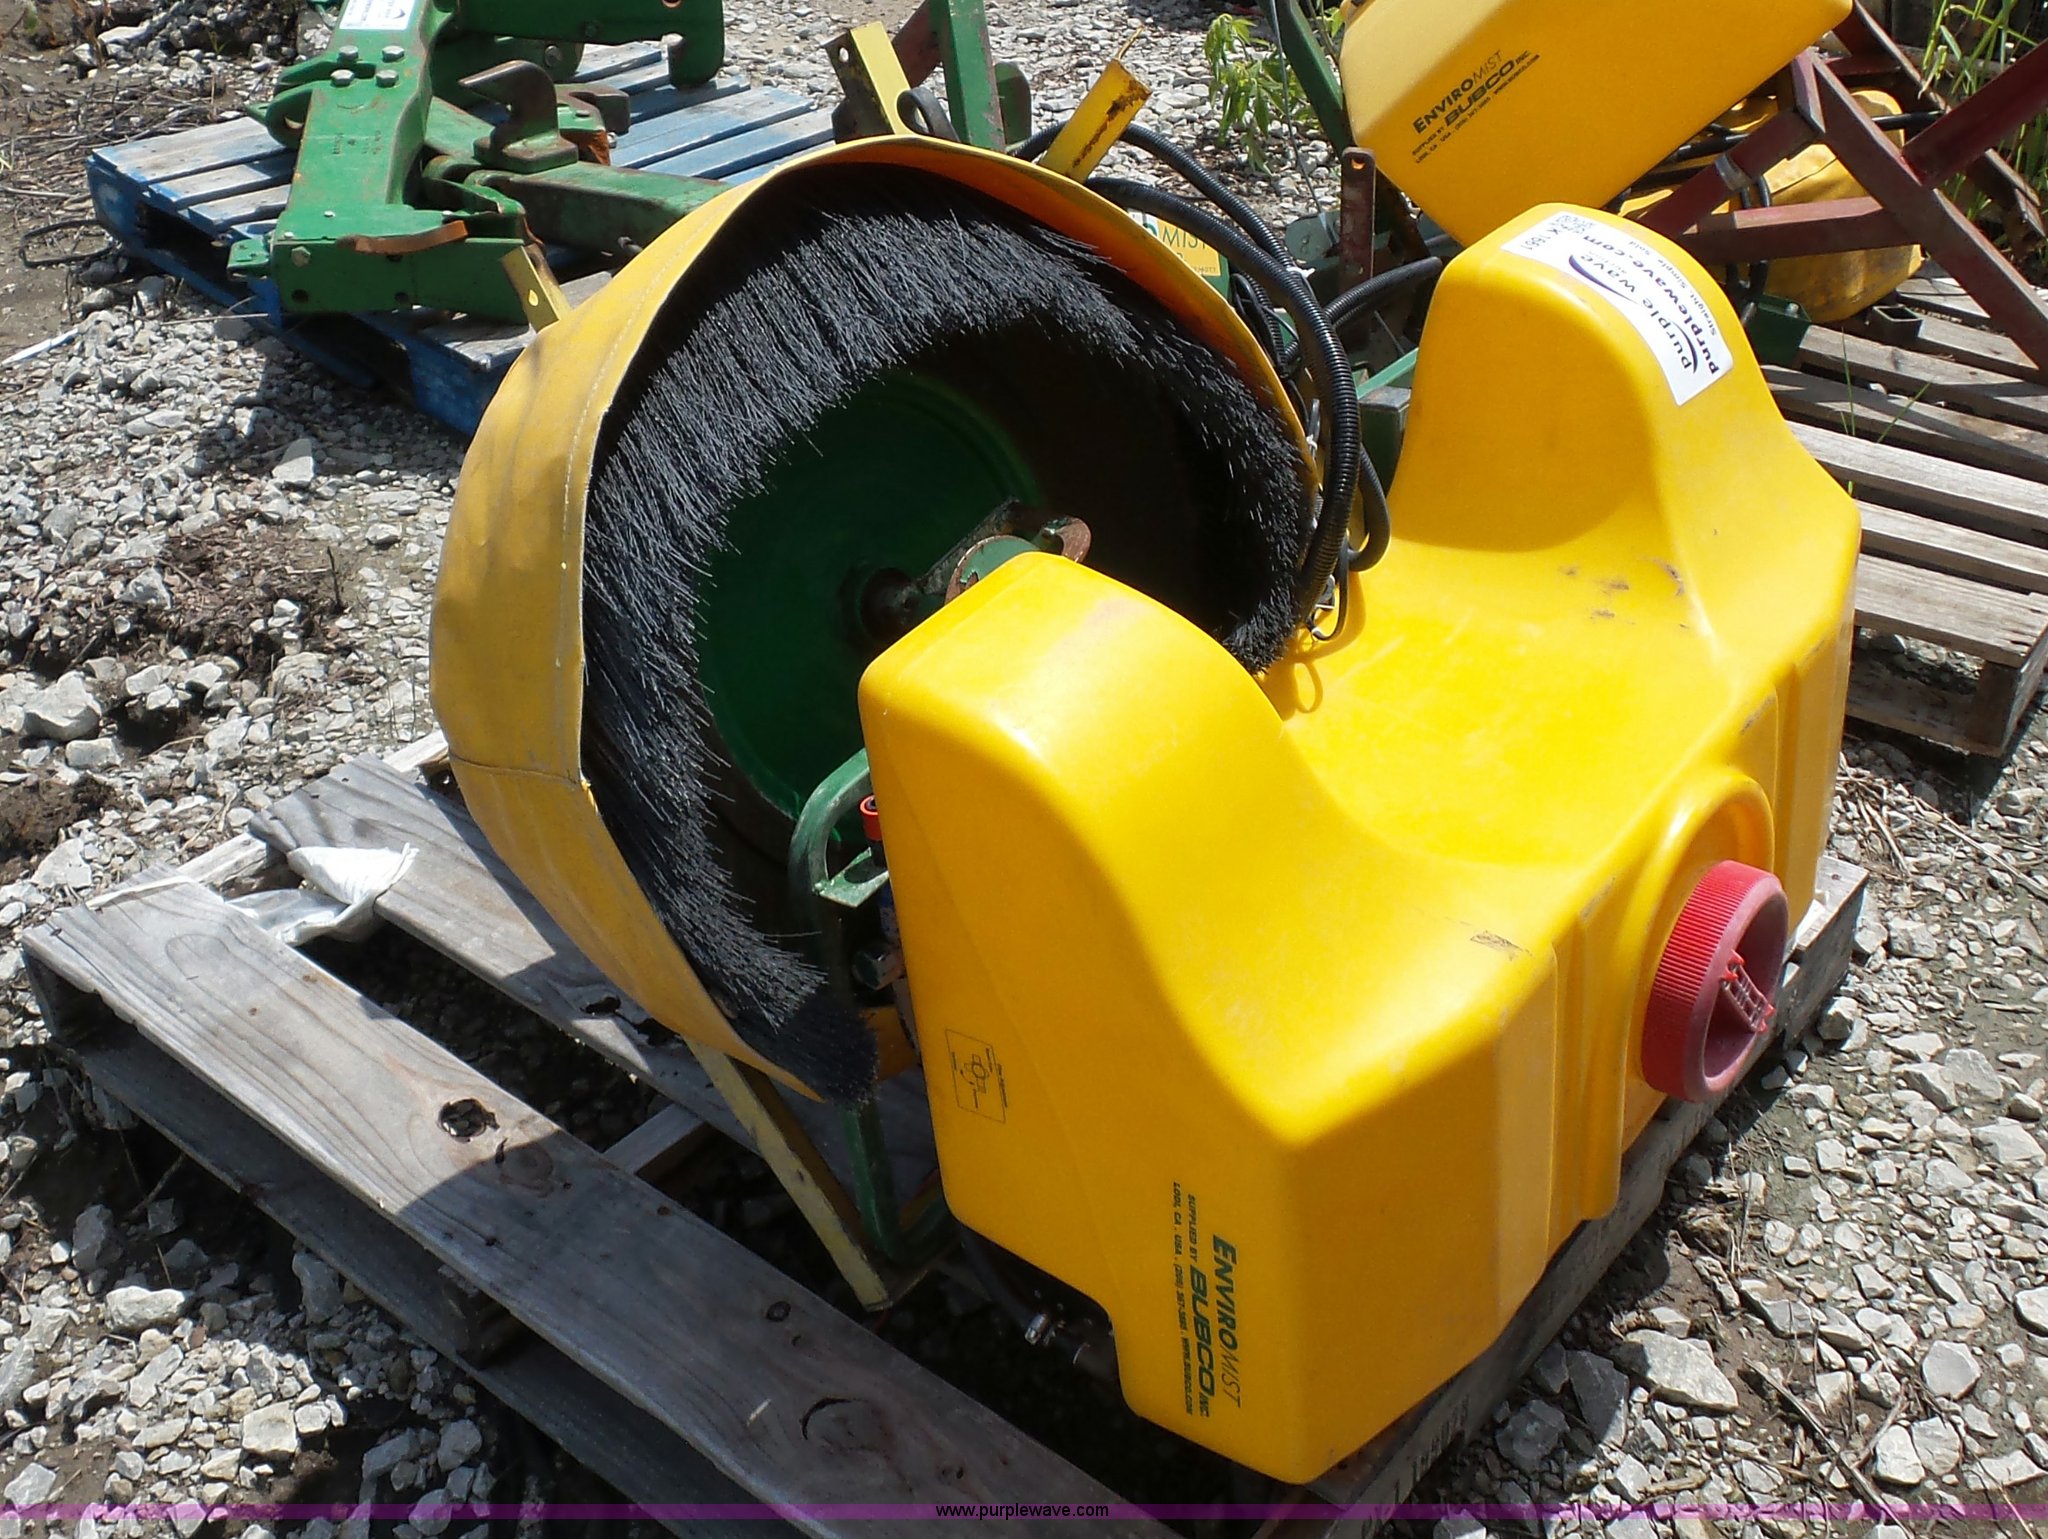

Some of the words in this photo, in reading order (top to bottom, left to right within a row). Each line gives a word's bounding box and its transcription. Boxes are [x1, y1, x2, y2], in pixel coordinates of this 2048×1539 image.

[1413, 49, 1504, 133] ENVIROMIST
[1444, 60, 1515, 127] BUBCO
[1580, 254, 1636, 292] wave
[1583, 235, 1720, 375] purplewave.com
[1642, 297, 1692, 369] purple
[1189, 1246, 1198, 1263] BY
[1190, 1265, 1215, 1397] BUBCO
[1212, 1234, 1241, 1408] ENVIROMIST
